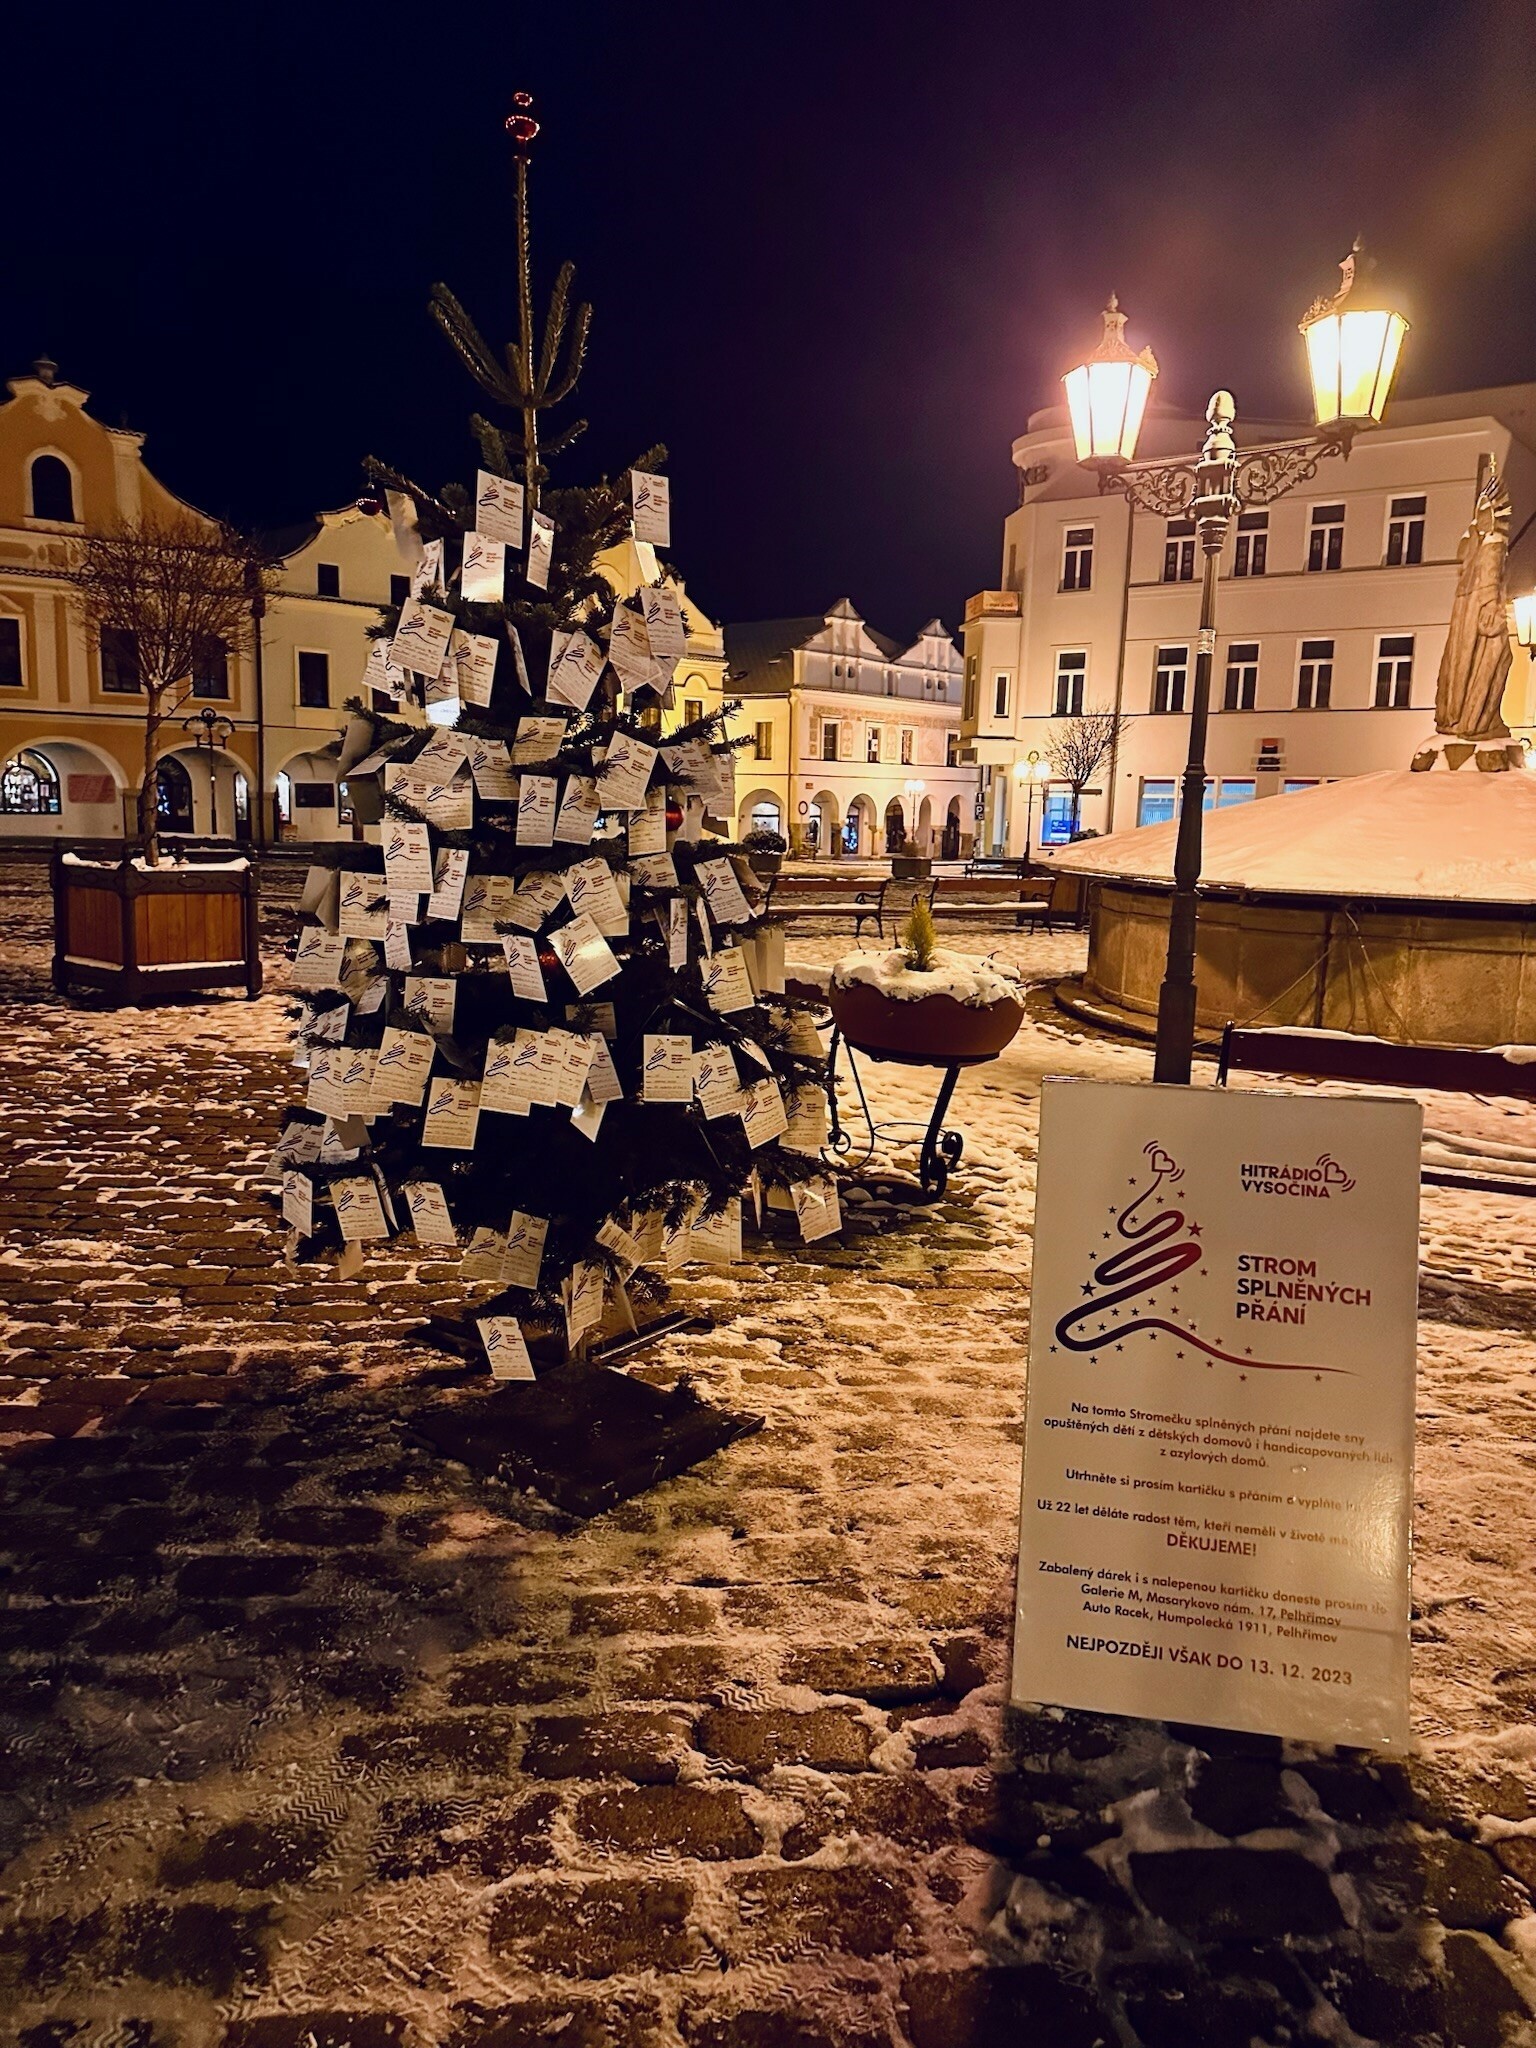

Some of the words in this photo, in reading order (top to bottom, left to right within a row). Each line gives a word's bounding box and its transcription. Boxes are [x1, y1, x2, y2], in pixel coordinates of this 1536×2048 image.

[1241, 1164, 1322, 1182] HITRÁDIO
[1242, 1180, 1330, 1198] VYSOČINA
[1238, 1255, 1316, 1278] STROM
[1237, 1278, 1371, 1306] SPLNĚNÝCH
[1236, 1299, 1306, 1325] PŘÁNÍ
[1044, 1418, 1109, 1433] opuštěných
[1113, 1424, 1135, 1435] dětí
[1149, 1428, 1199, 1444] dětských
[1203, 1434, 1251, 1449] domovů
[1256, 1439, 1259, 1449] i
[1263, 1440, 1369, 1461] handicapovaných
[1072, 1402, 1088, 1413] Na
[1092, 1406, 1126, 1418] tomto
[1130, 1409, 1191, 1425] Stromečku
[1196, 1417, 1255, 1433] splněných
[1259, 1424, 1290, 1436] přání
[1295, 1428, 1340, 1441] najdete
[1344, 1435, 1364, 1446] sny
[1170, 1448, 1227, 1464] azylových
[1066, 1469, 1116, 1484] Utrhněte
[1120, 1475, 1129, 1485] si
[1133, 1479, 1173, 1491] prosím
[1178, 1482, 1225, 1497] kartičku
[1229, 1490, 1235, 1498] s
[1239, 1490, 1282, 1503] přáním
[1038, 1499, 1052, 1510] Už
[1056, 1502, 1070, 1512] 22
[1075, 1503, 1089, 1514] let
[1092, 1506, 1129, 1519] děláte
[1133, 1512, 1170, 1524] radost
[1174, 1516, 1199, 1530] těm,
[1204, 1519, 1230, 1532] kteří
[1235, 1526, 1275, 1537] neměli
[1167, 1532, 1257, 1557] DĚKUJEME!
[1039, 1561, 1093, 1580] Zabalený
[1097, 1568, 1131, 1582] dárek
[1136, 1572, 1139, 1583] i
[1152, 1576, 1216, 1592] nalepenou
[1220, 1583, 1268, 1599] kartičku
[1273, 1590, 1320, 1605] doneste
[1325, 1600, 1367, 1612] prosím
[1081, 1584, 1124, 1598] Galerie
[1128, 1590, 1142, 1603] M,
[1146, 1591, 1219, 1610] Masarykovo
[1224, 1602, 1254, 1616] nám.
[1260, 1606, 1276, 1620] 17,
[1280, 1608, 1342, 1627] Pelhřimov
[1083, 1601, 1110, 1614] Auto
[1115, 1605, 1153, 1621] Racek,
[1158, 1610, 1232, 1629] Humpolecká
[1239, 1621, 1272, 1636] 1911,
[1277, 1625, 1338, 1643] Pelhřimov
[1067, 1635, 1162, 1660] NEJPOZDĚJI
[1169, 1646, 1211, 1666] VŠAK
[1217, 1654, 1242, 1670] DO
[1251, 1659, 1273, 1675] 13.
[1282, 1663, 1304, 1679] 12.
[1312, 1667, 1351, 1685] 2023
